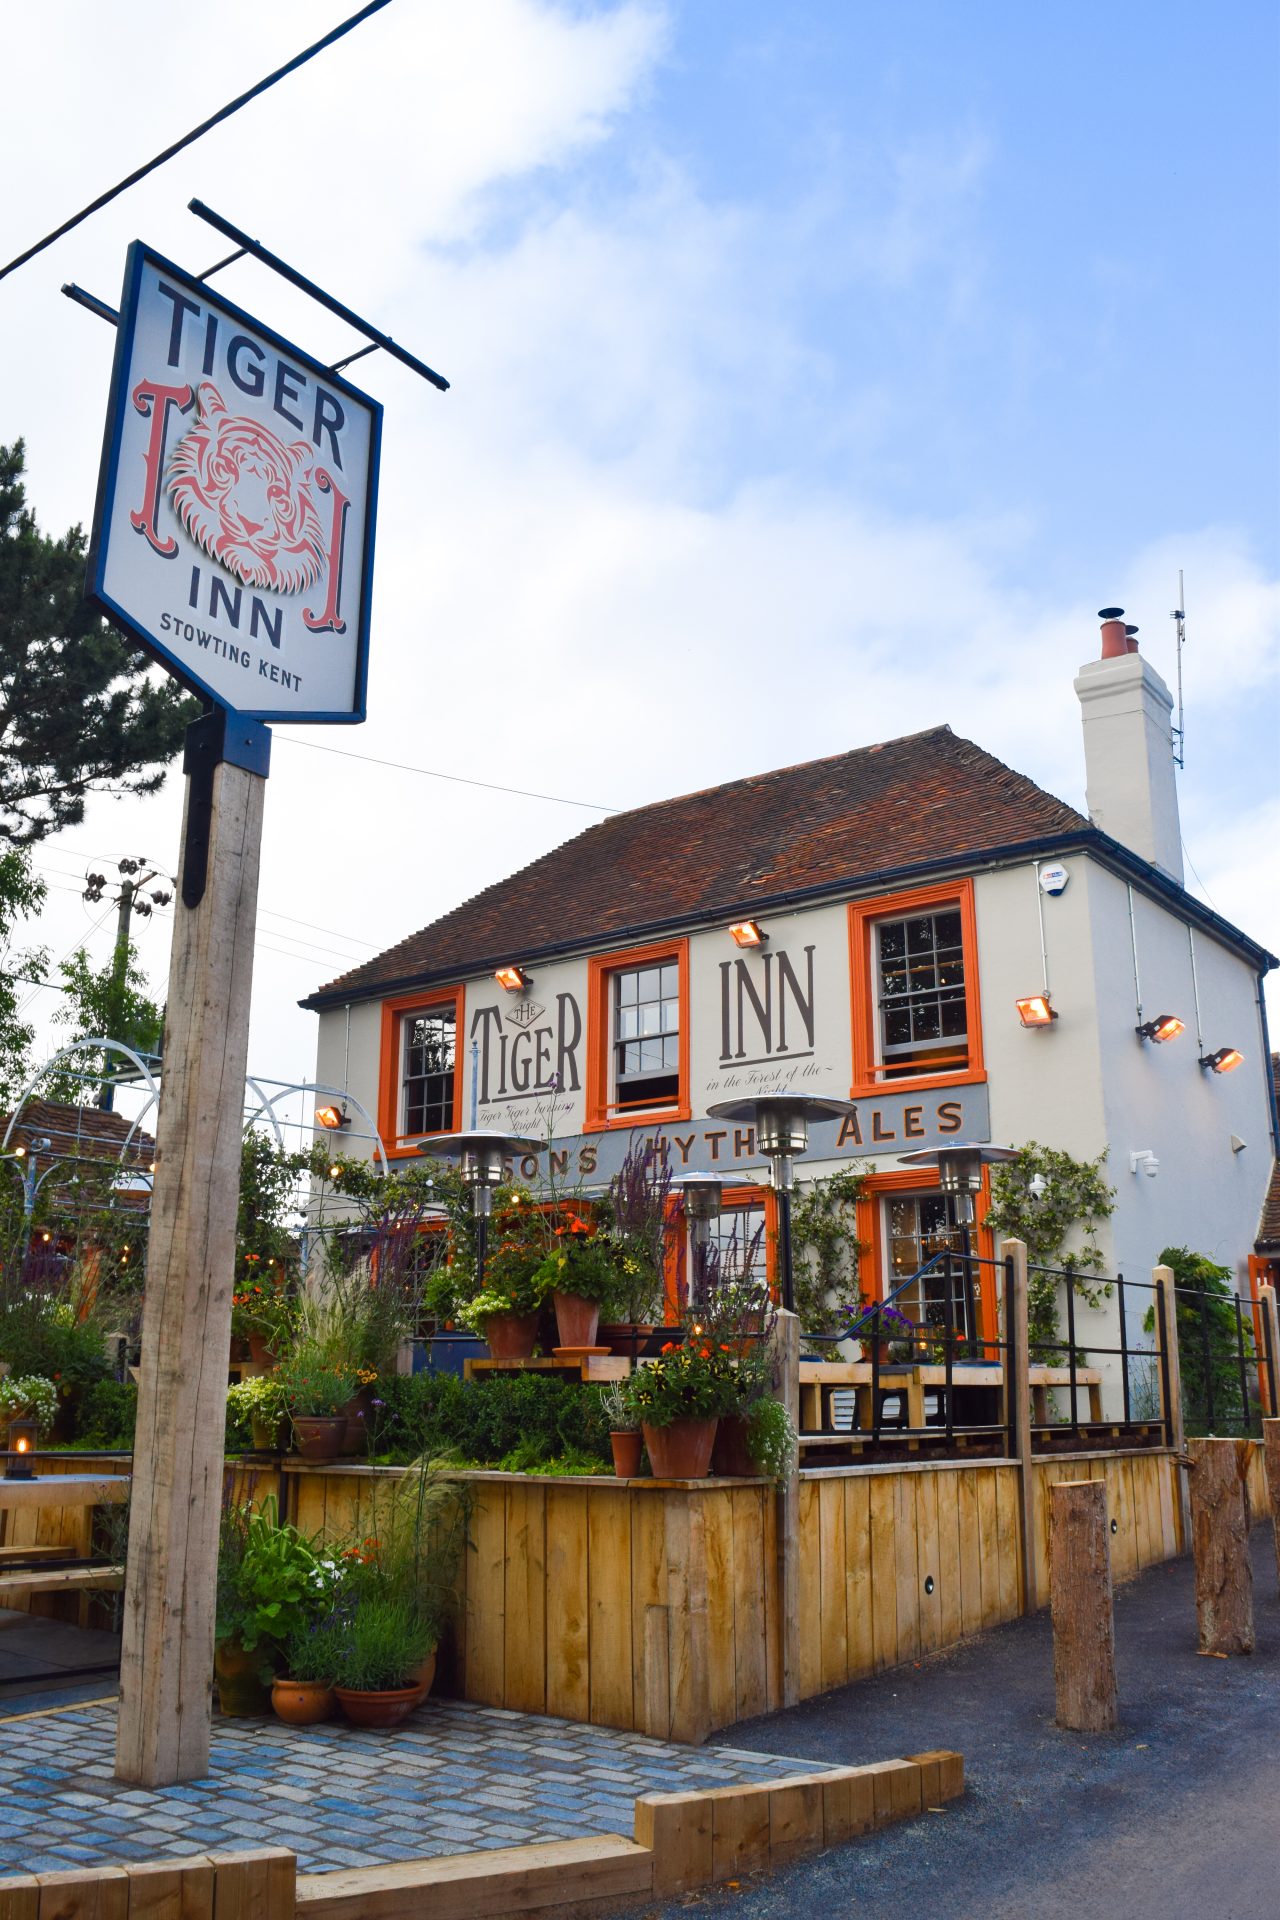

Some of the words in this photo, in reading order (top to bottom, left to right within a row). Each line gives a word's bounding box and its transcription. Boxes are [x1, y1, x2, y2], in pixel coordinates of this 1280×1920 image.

[158, 280, 346, 473] TIGER
[188, 565, 284, 650] INN
[159, 612, 251, 669] STOWTING
[258, 658, 303, 693] KENT
[513, 1002, 537, 1022] THE
[718, 945, 816, 1061] INN
[469, 992, 582, 1105] TIGER
[706, 1078, 720, 1091] in
[723, 1074, 742, 1088] the
[745, 1068, 782, 1085] Forest
[785, 1066, 799, 1082] of
[802, 1062, 822, 1077] the
[479, 1109, 502, 1126] Tiger
[504, 1105, 531, 1120] Tiger
[642, 1128, 756, 1168] HYTH
[836, 1102, 963, 1148] ALES
